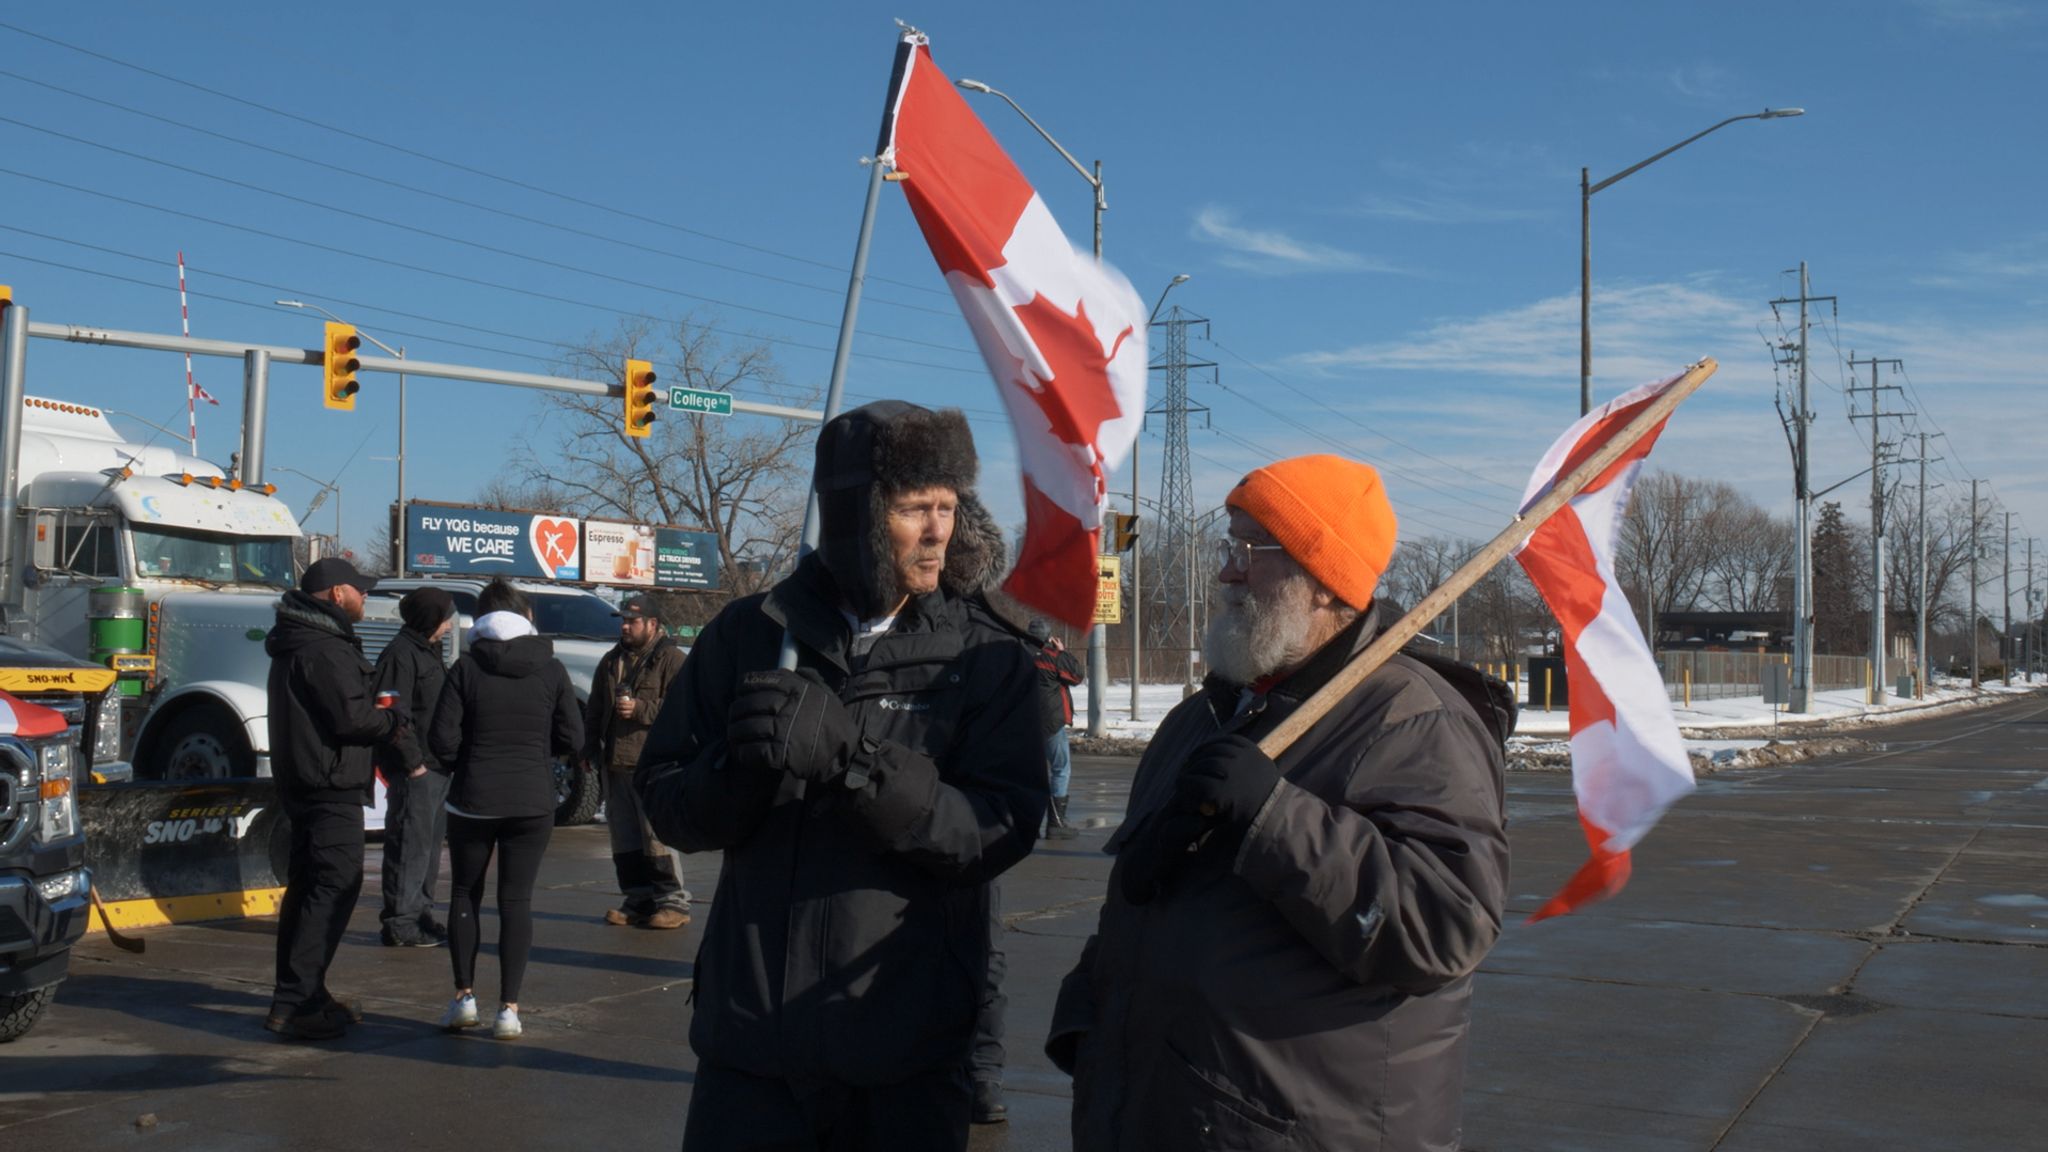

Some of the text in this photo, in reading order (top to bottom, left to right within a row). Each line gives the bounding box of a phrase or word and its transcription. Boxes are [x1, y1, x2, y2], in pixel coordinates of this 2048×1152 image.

[673, 391, 718, 412] College
[422, 517, 520, 536] FLY YQG because
[446, 536, 514, 556] WE CARE
[589, 531, 624, 545] Espresso
[1095, 591, 1115, 600] OUTE
[27, 672, 76, 684] SNO-WAY
[169, 807, 227, 818] SERIES
[144, 808, 264, 844] SNO-WY
